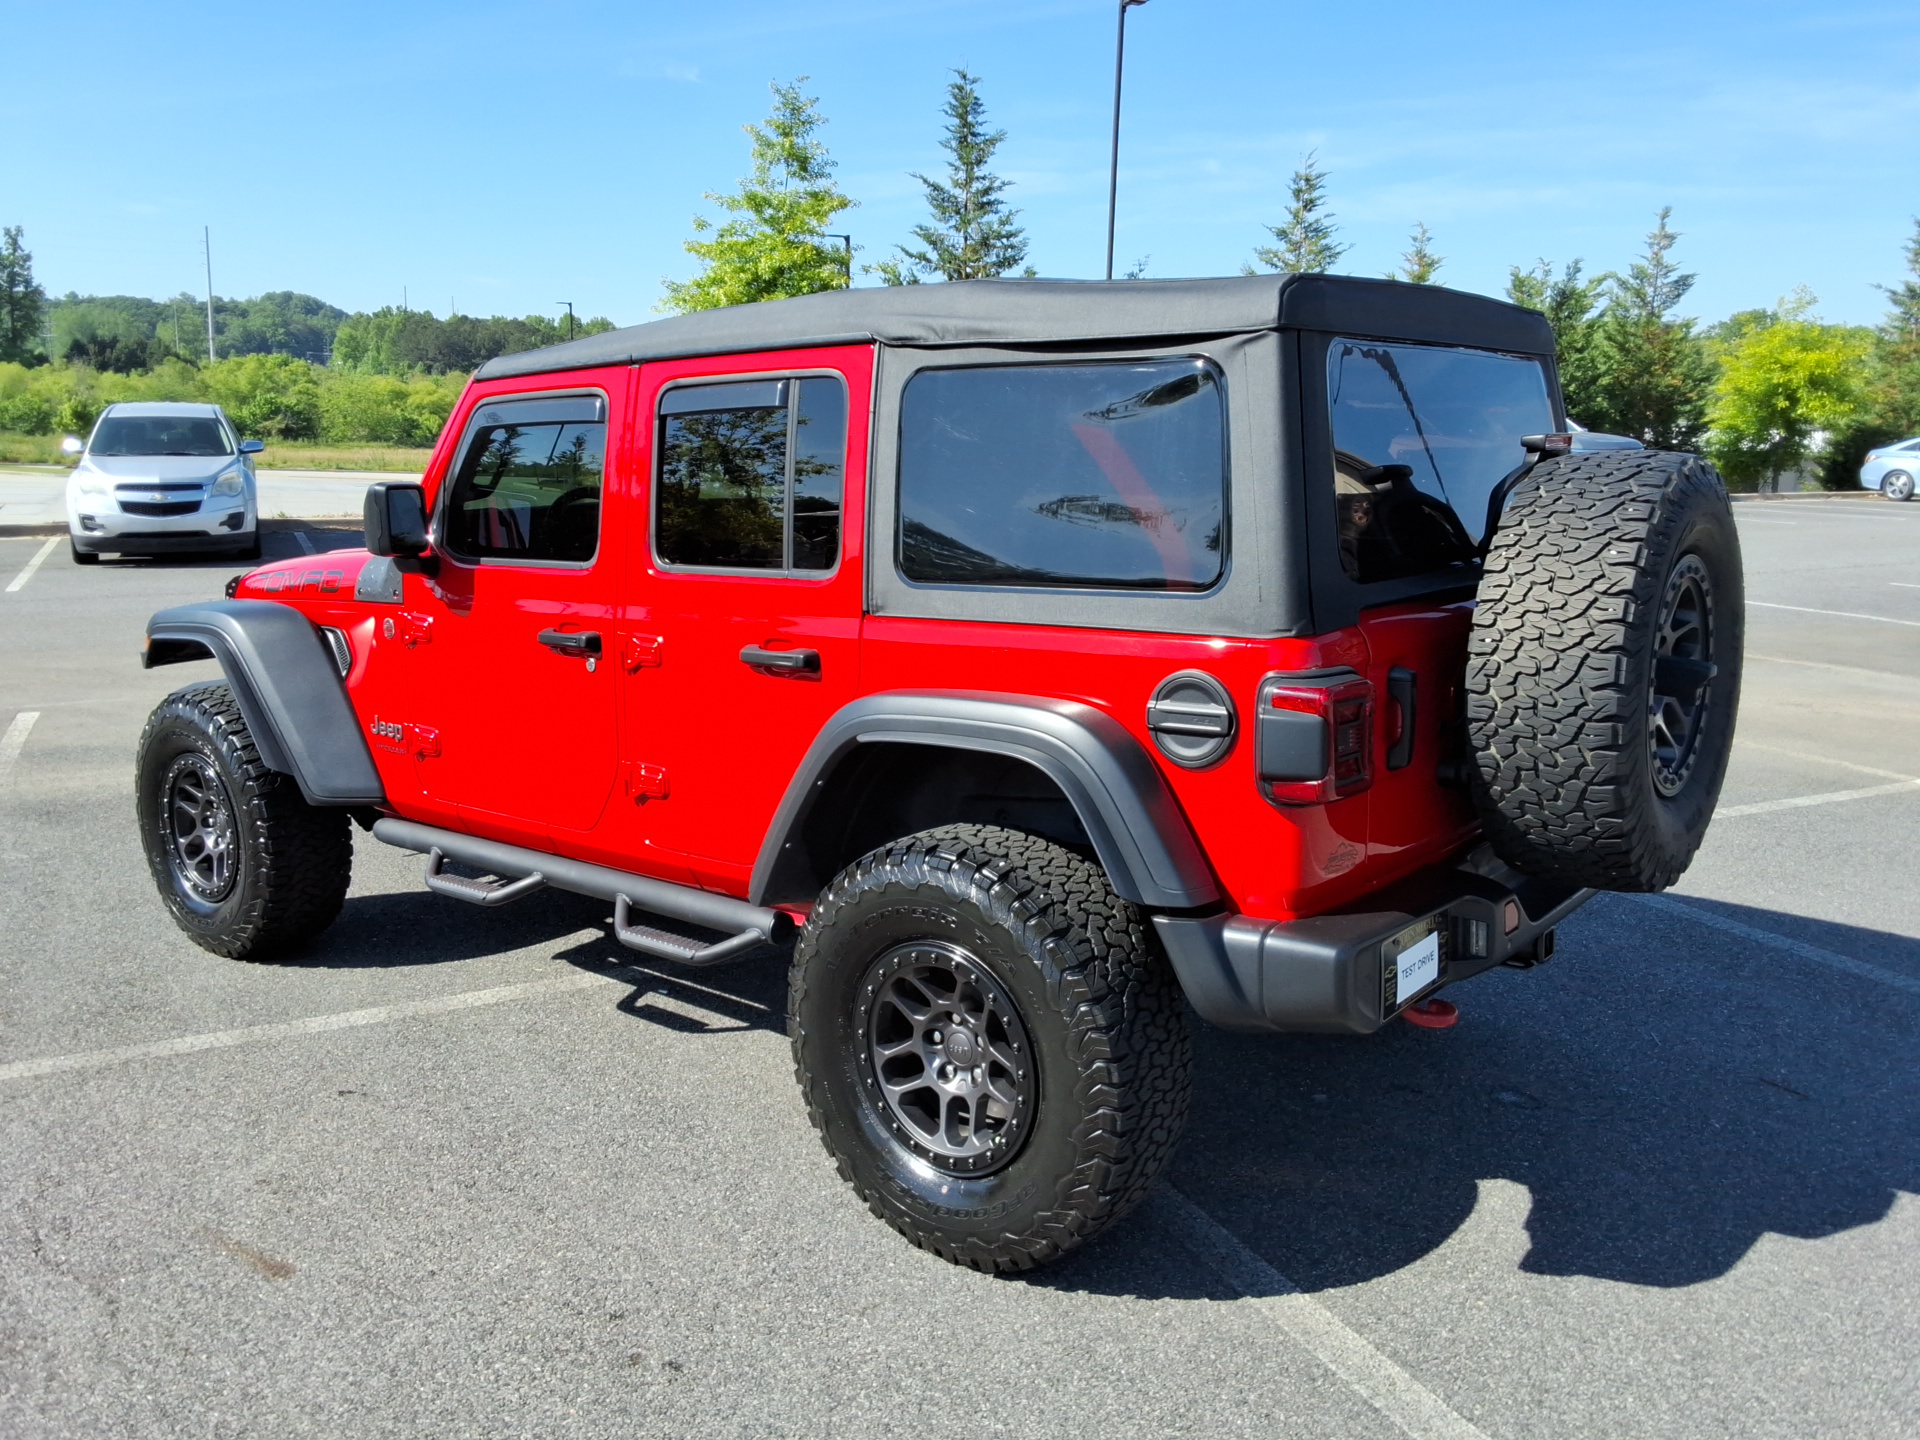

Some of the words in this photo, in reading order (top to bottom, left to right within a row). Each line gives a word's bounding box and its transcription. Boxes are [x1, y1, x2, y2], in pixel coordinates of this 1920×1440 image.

[370, 714, 403, 743] Jeep
[1401, 962, 1417, 980] TEST
[1417, 950, 1435, 971] DRIVE
